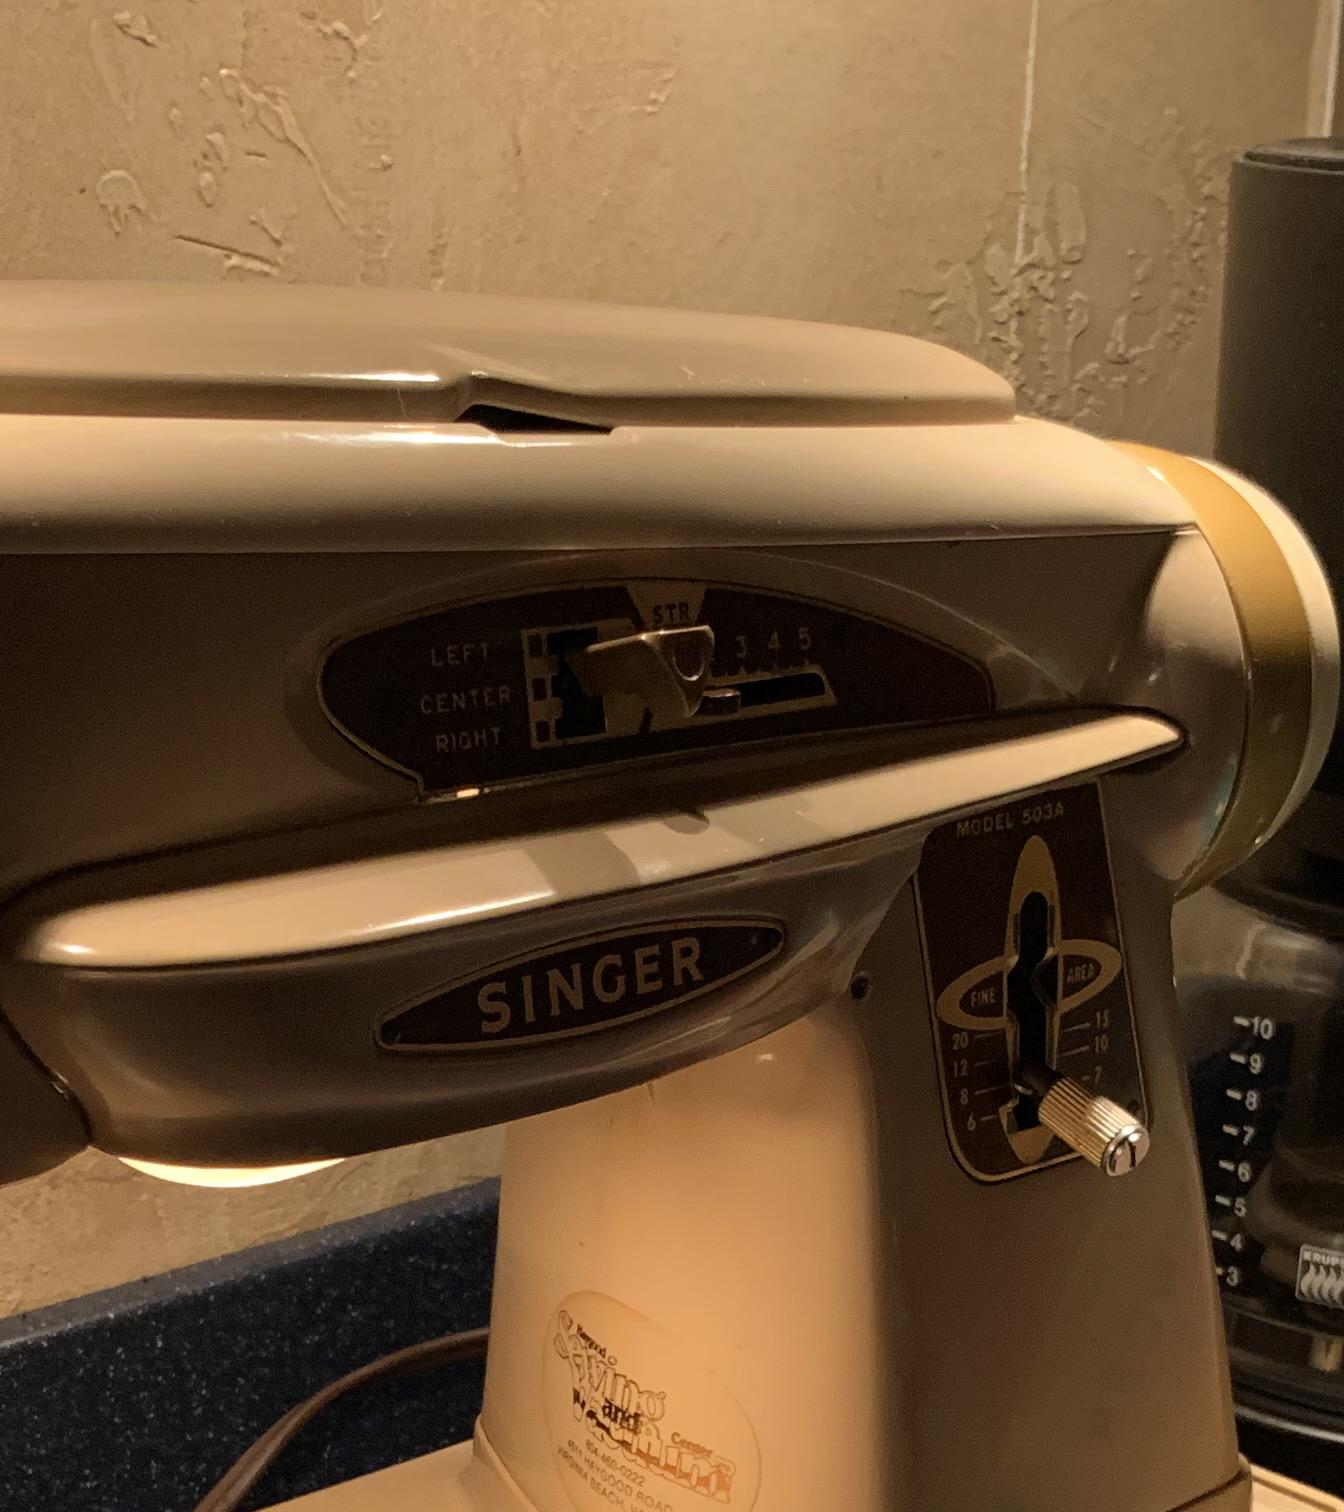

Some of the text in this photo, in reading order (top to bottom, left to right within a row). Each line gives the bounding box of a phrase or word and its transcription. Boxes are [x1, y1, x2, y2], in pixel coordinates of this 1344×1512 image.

[430, 641, 492, 668] LEFT
[419, 684, 514, 716] CENTER
[434, 726, 502, 754] RIGHT
[955, 811, 1014, 839] MODEL
[476, 935, 705, 1035] SINGER
[969, 986, 997, 1008] FINE
[1251, 1014, 1274, 1041] 10
[1248, 1052, 1264, 1075] 9
[1244, 1089, 1260, 1112] 8
[1241, 1125, 1255, 1147] 7
[1237, 1159, 1253, 1183] 6
[1233, 1196, 1248, 1218] 5
[1229, 1233, 1245, 1253] 4
[1225, 1265, 1241, 1288] 3
[601, 1397, 643, 1436] and
